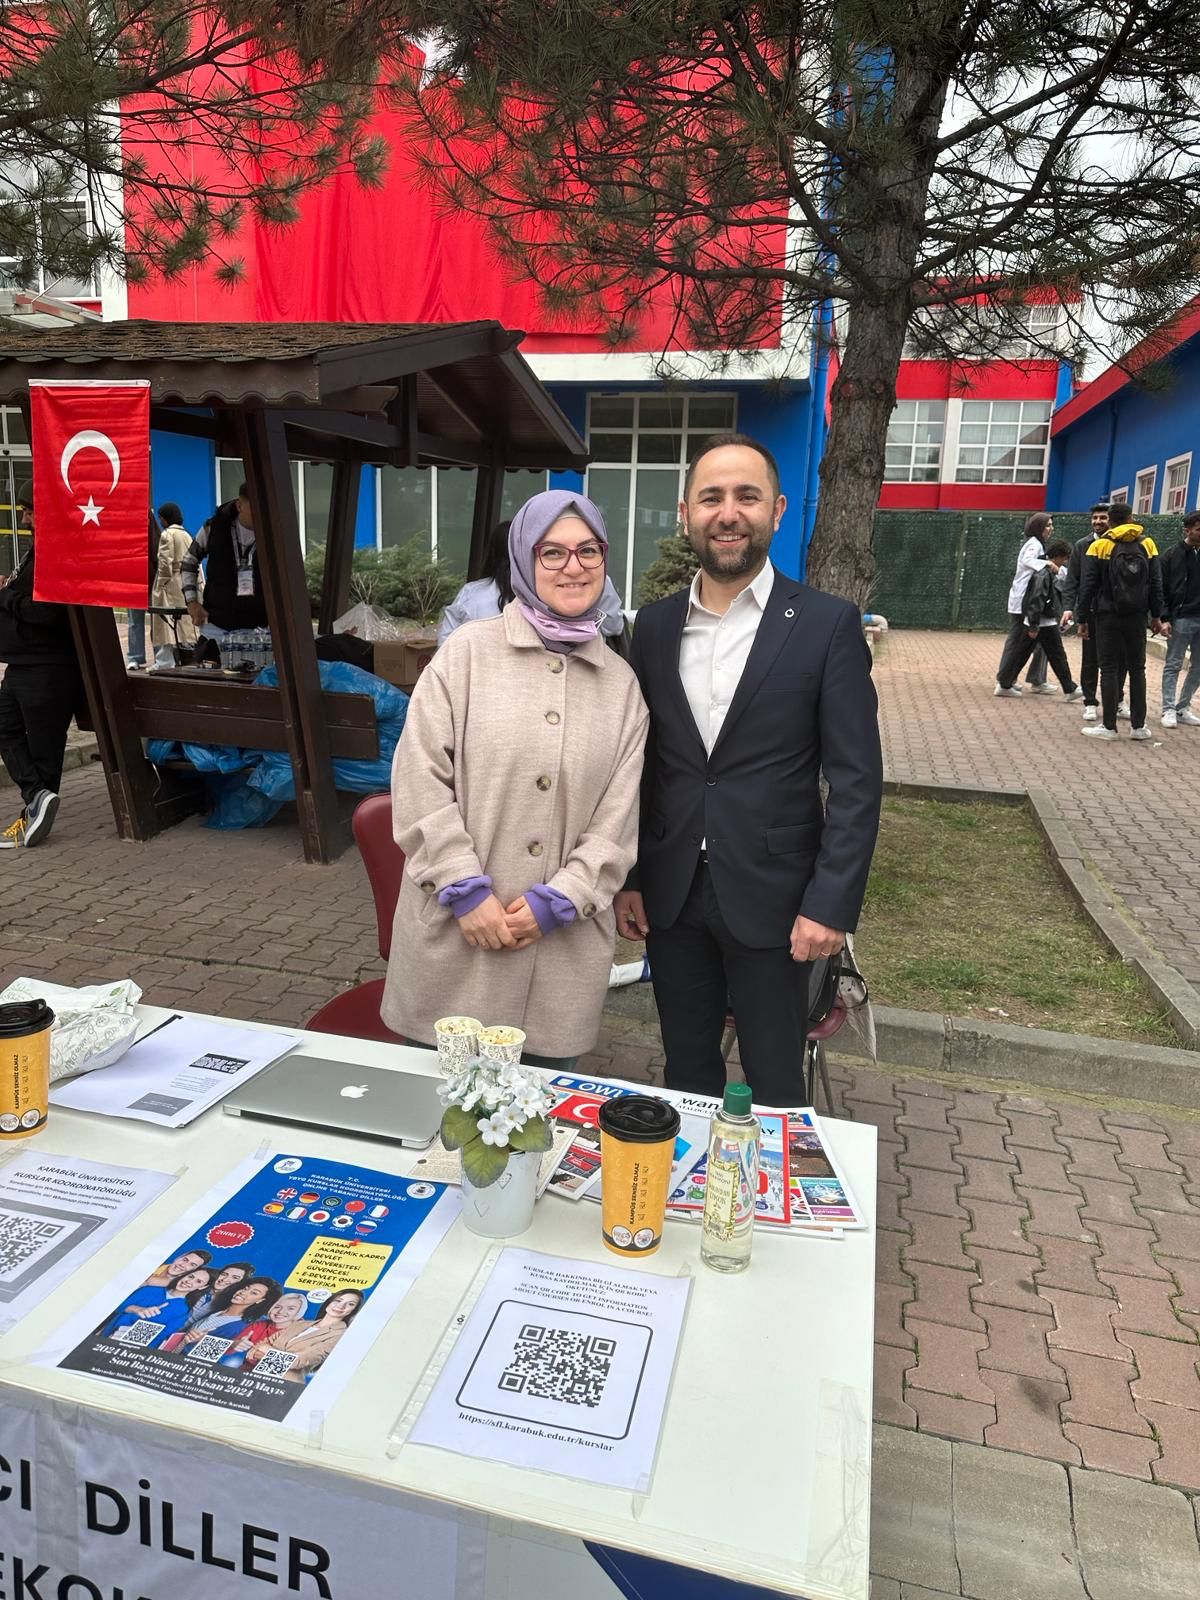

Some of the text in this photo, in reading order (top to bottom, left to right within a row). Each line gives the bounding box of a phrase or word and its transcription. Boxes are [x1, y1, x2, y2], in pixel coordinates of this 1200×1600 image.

[14, 1171, 137, 1198] KURSLAR KOORDİNATÖRLÜĞÜ
[37, 1165, 135, 1187] KARABÜK ÜNİVERSİTESİ
[629, 1201, 637, 1224] KAMPÜS
[314, 1253, 342, 1261] DEVLET
[318, 1247, 386, 1261] AKADEMİK KADRO
[322, 1240, 350, 1249] UZMAN
[301, 1271, 368, 1285] E-DEVLET ONAYLI
[523, 1265, 554, 1276] KURSLAR
[555, 1271, 592, 1283] HAKKINDA
[612, 1281, 638, 1291] ALMAK
[638, 1286, 658, 1295] VEYA
[530, 1272, 553, 1281] KURSA
[553, 1277, 599, 1290] KAYDOLMAK
[626, 1289, 647, 1298] KODU
[512, 1286, 537, 1295] ABOUT
[537, 1290, 569, 1302] COURSES
[580, 1298, 606, 1308] ENROL
[520, 1282, 539, 1291] SCAN
[551, 1287, 570, 1297] CODE
[571, 1290, 582, 1298] TO
[582, 1292, 597, 1301] GET
[597, 1295, 649, 1311] INFORMATION
[109, 1356, 132, 1369] Son
[131, 1360, 174, 1380] Başvuru
[191, 1376, 226, 1393] Nisan
[202, 1368, 236, 1384] Nisan
[253, 1381, 286, 1397] Mayıs
[458, 1411, 615, 1453] https://sfl.karabuk.edu.tr/kurslar
[84, 1478, 333, 1600] DİLLER
